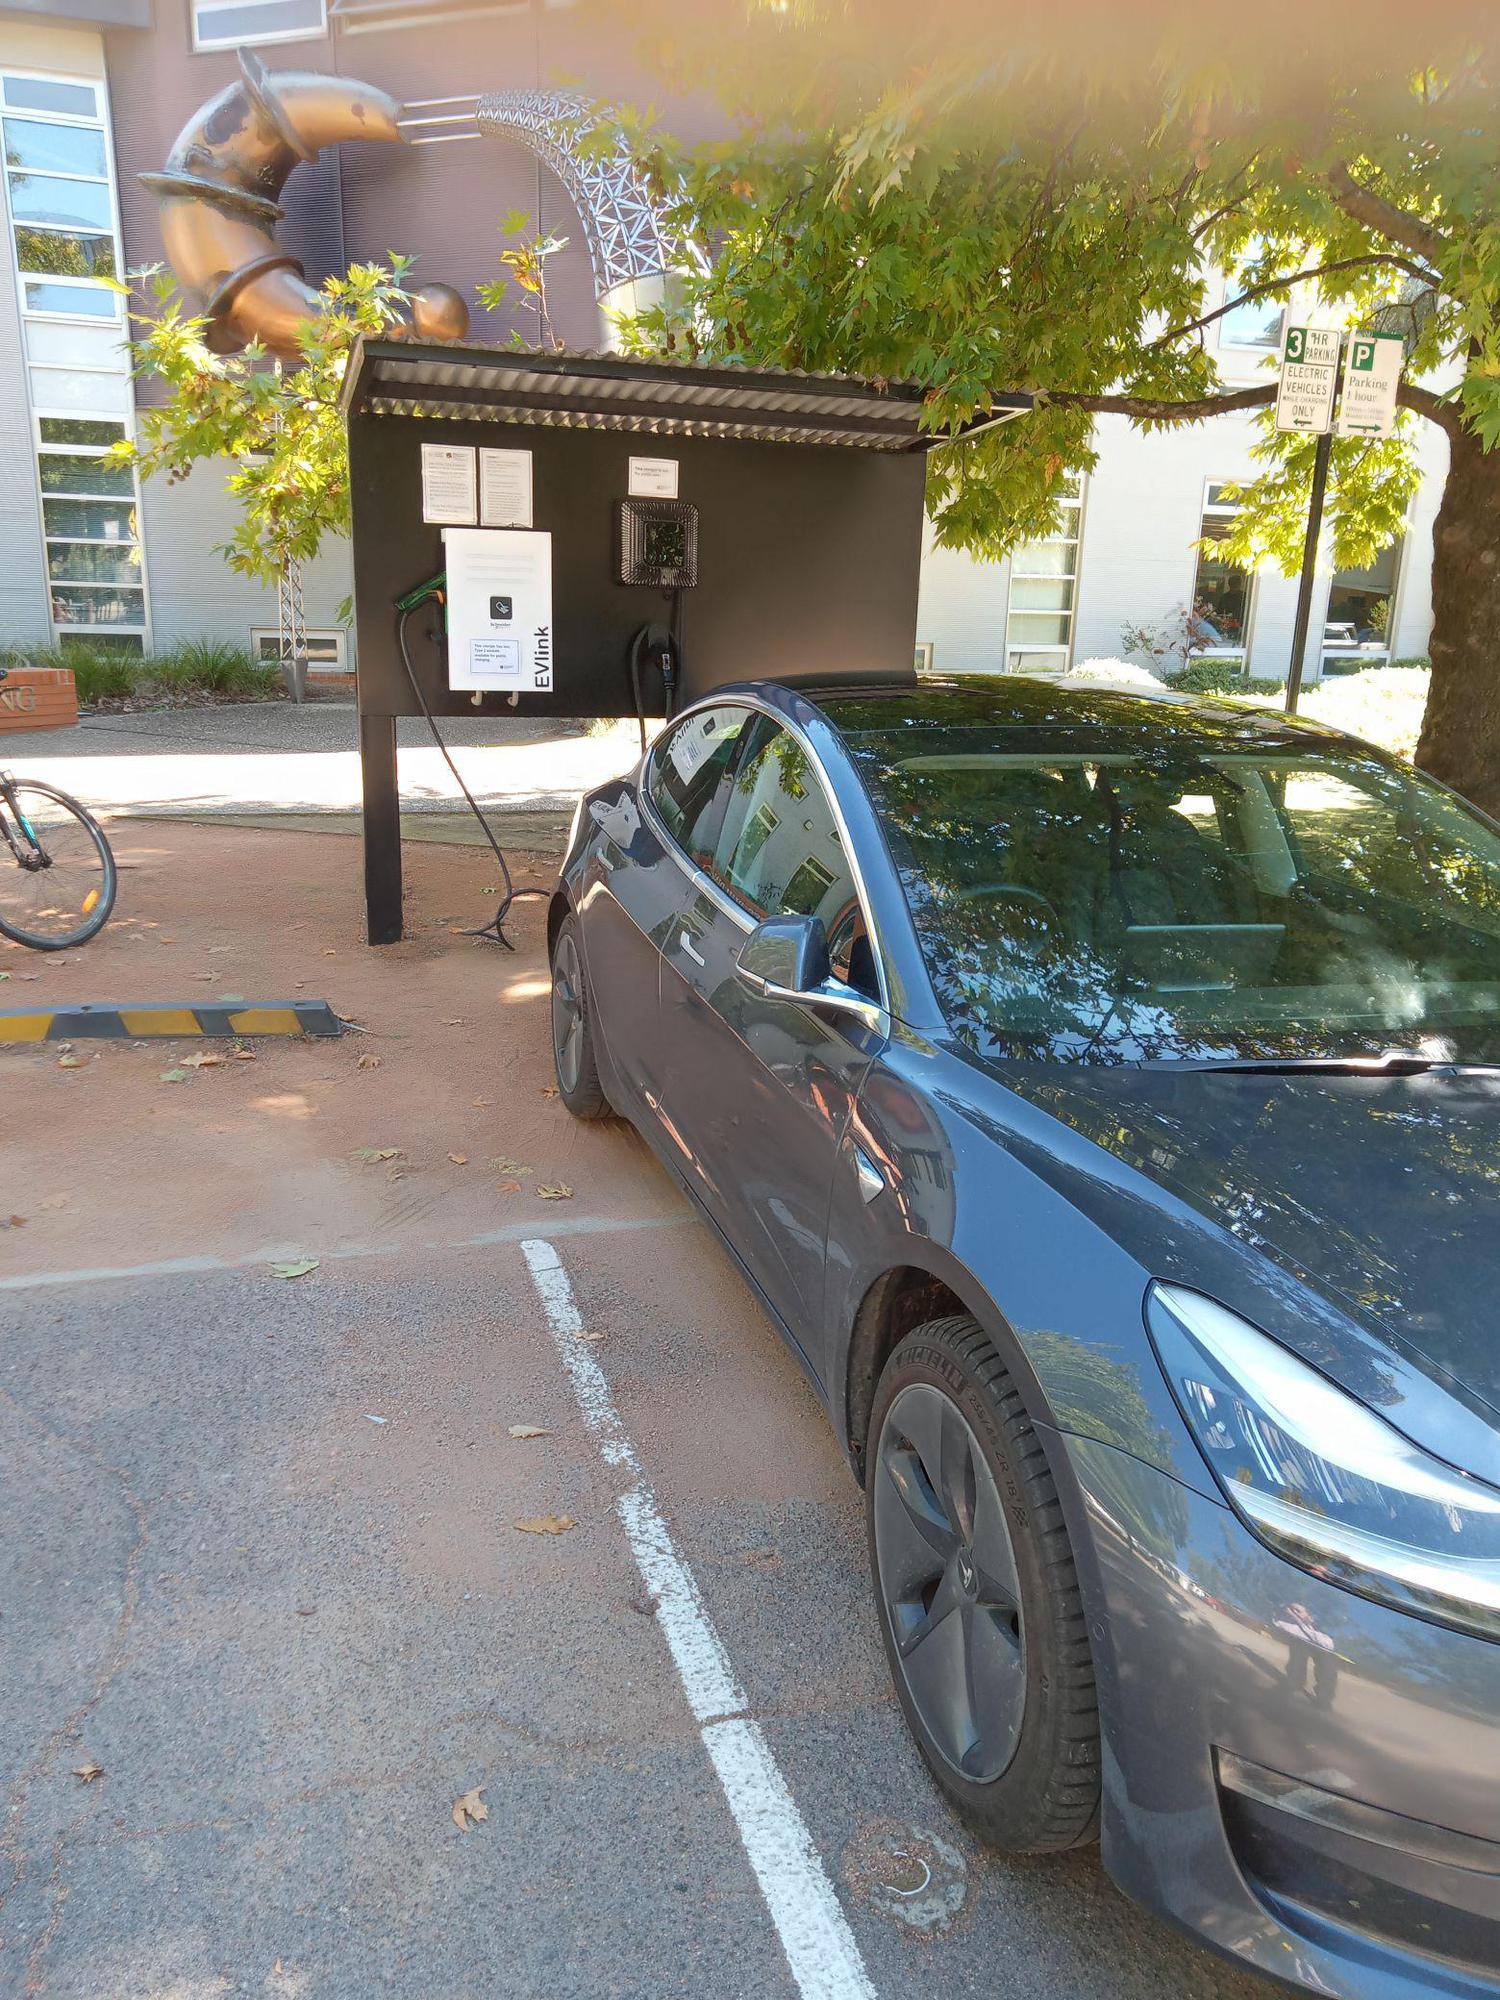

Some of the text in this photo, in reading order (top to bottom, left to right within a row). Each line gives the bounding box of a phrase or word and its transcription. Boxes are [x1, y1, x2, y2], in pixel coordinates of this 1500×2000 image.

[1288, 331, 1303, 357] 3
[1304, 347, 1337, 362] PARKING
[1356, 345, 1371, 367] P
[1288, 366, 1329, 380] ELECTRIC
[1286, 381, 1327, 396] VEHICLES
[1350, 376, 1388, 391] Parking
[1355, 389, 1377, 402] hour
[1291, 405, 1316, 417] ONLY
[534, 626, 550, 688] EVlink
[898, 1347, 963, 1391] MICHELIN
